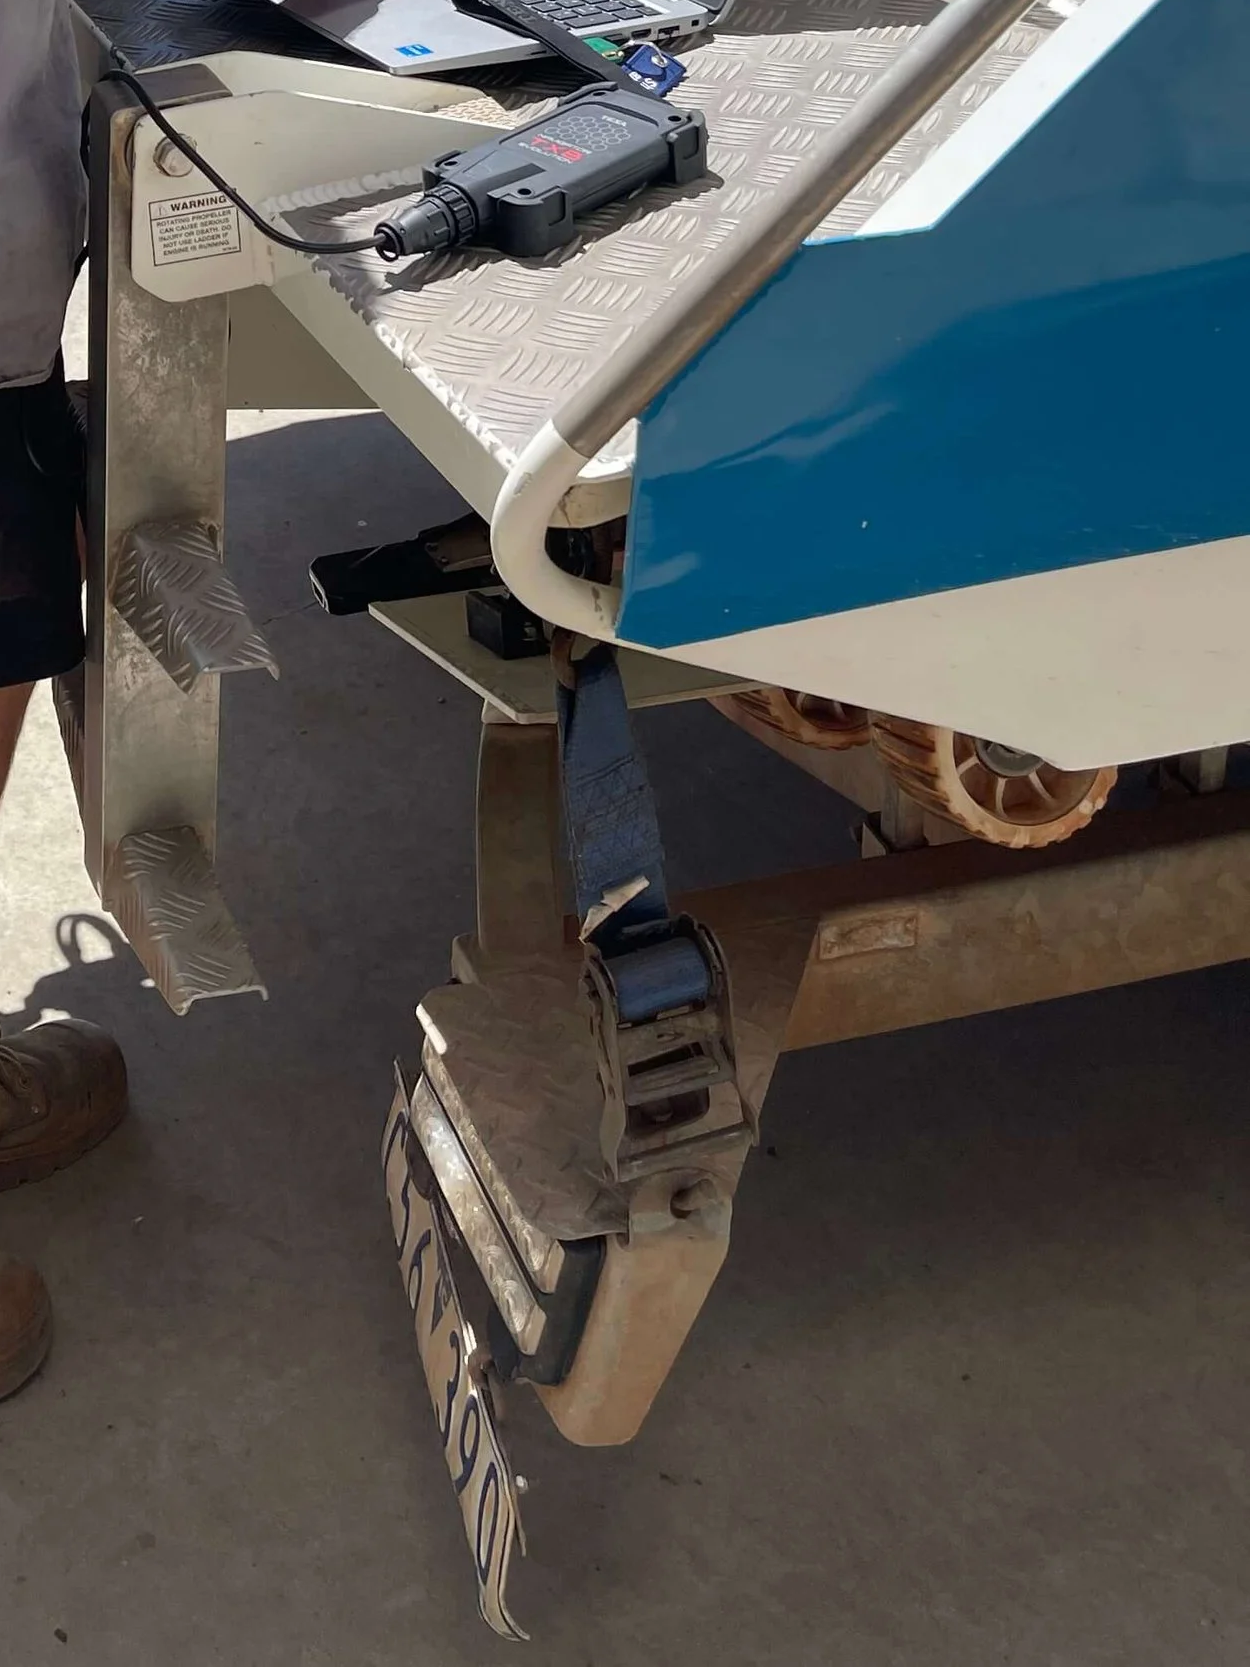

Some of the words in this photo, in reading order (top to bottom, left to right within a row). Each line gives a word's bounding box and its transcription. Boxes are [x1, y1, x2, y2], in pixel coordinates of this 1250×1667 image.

[170, 194, 228, 211] WARNING
[156, 217, 191, 227] ROTATING
[191, 209, 231, 221] PROPELLER
[175, 222, 198, 231] CAUSE
[200, 217, 230, 227] SERIOUS
[163, 240, 177, 248] NOT
[178, 237, 192, 245] USE
[194, 233, 221, 243] LADDER
[163, 246, 188, 255] ENGINE
[198, 239, 230, 249] RUNNING
